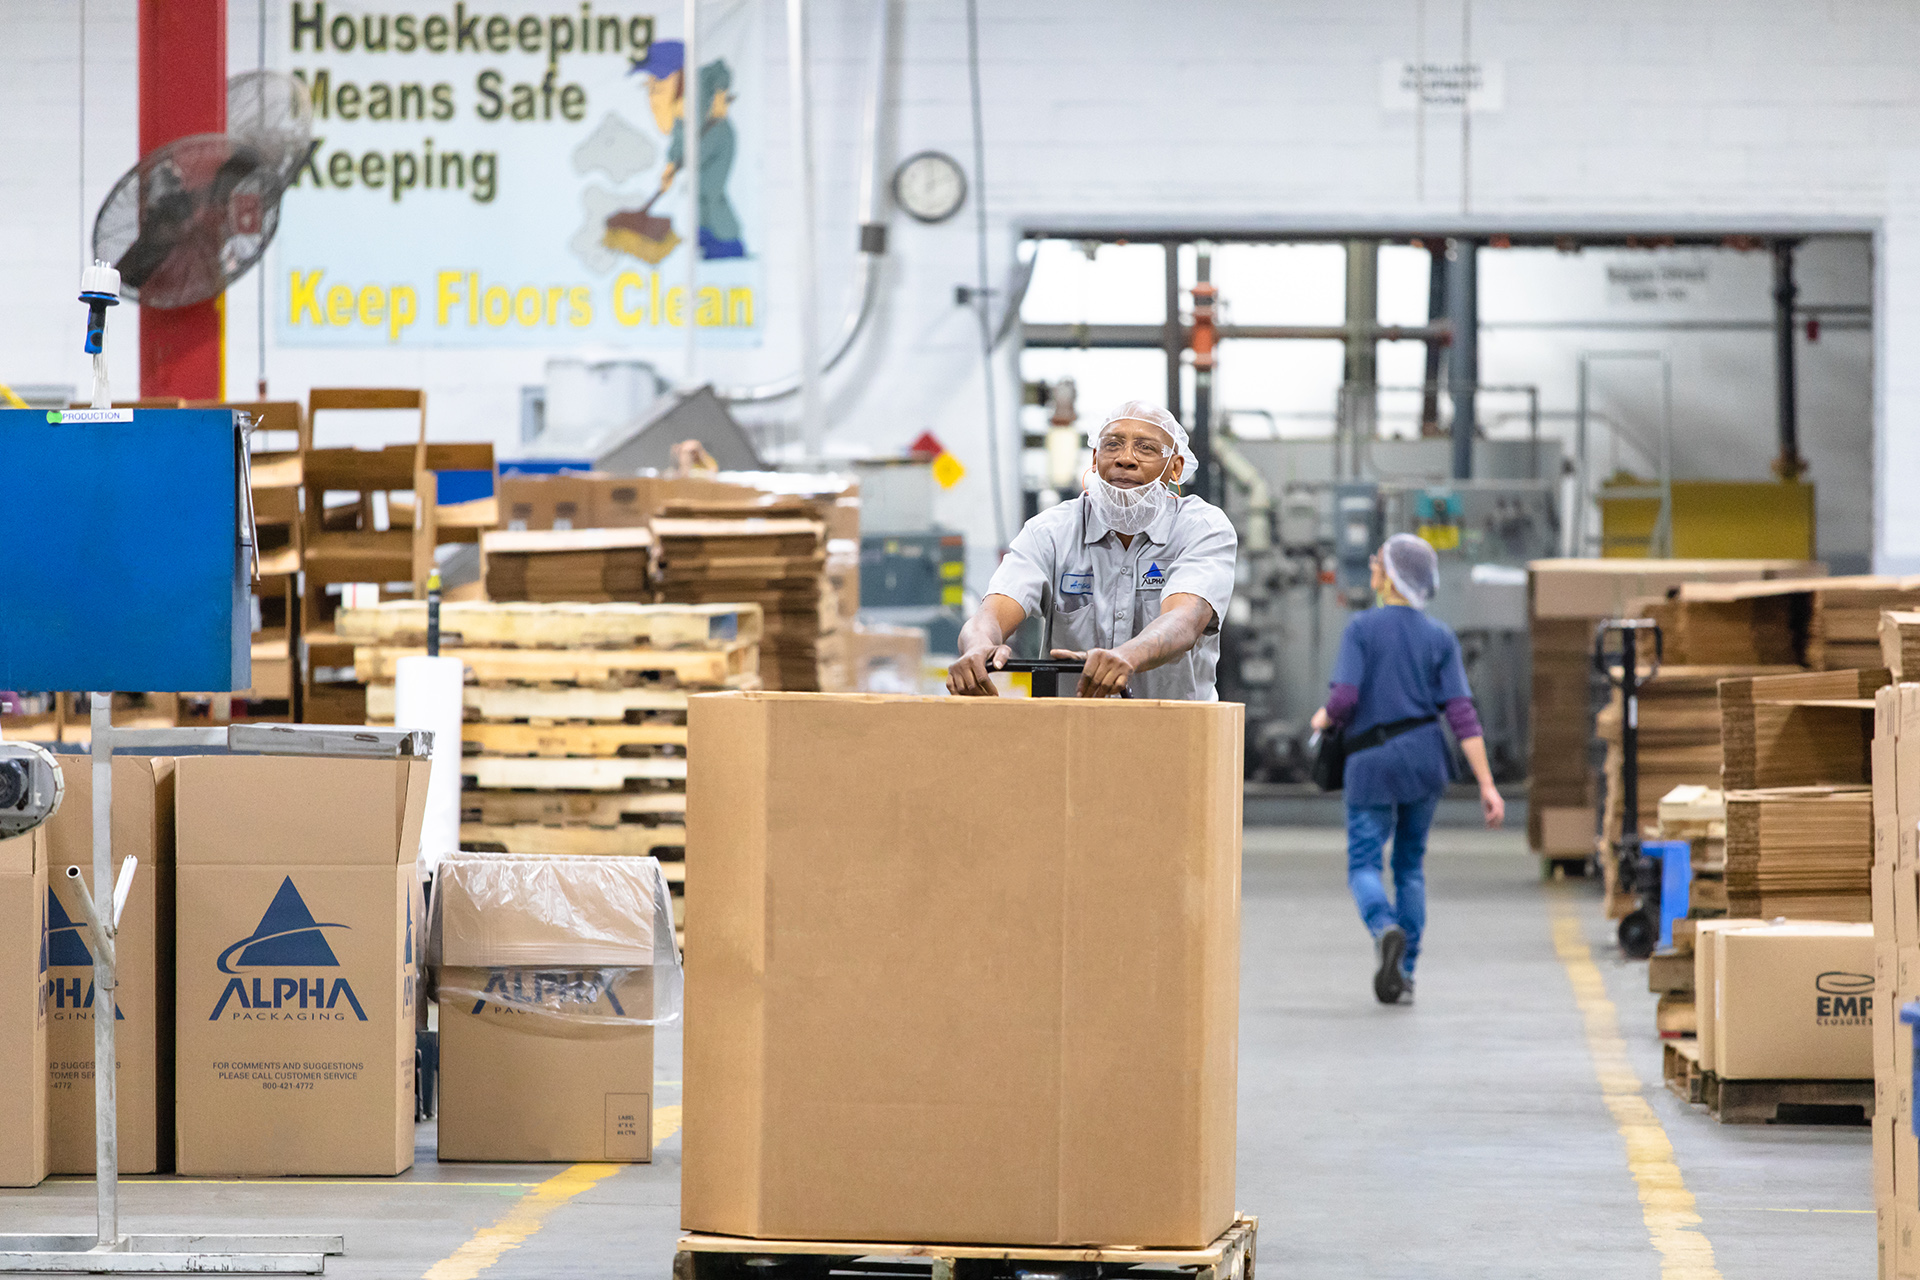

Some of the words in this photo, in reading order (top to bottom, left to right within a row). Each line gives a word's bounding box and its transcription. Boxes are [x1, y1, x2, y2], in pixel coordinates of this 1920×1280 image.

[291, 2, 656, 72] Housekeeping
[292, 70, 455, 121] Means
[475, 69, 587, 121] Safe
[289, 270, 416, 342] Keep
[437, 270, 593, 327] Floors
[613, 270, 755, 328] Clean
[62, 412, 121, 420] PRODUCTION
[1141, 579, 1166, 587] ALPHA
[208, 978, 369, 1021] ALPHA
[233, 1012, 345, 1021] PACKAGING
[212, 1061, 230, 1070] FOR
[231, 1061, 281, 1070] COMMENTS
[282, 1061, 301, 1070] AND
[302, 1061, 364, 1070] SUGGESTIONS
[218, 1071, 250, 1080] PLEASE
[251, 1071, 273, 1080] CALL
[274, 1071, 322, 1080] CUSTOMER
[323, 1071, 358, 1080] SERVICE
[262, 1082, 314, 1090] 800-421-4772
